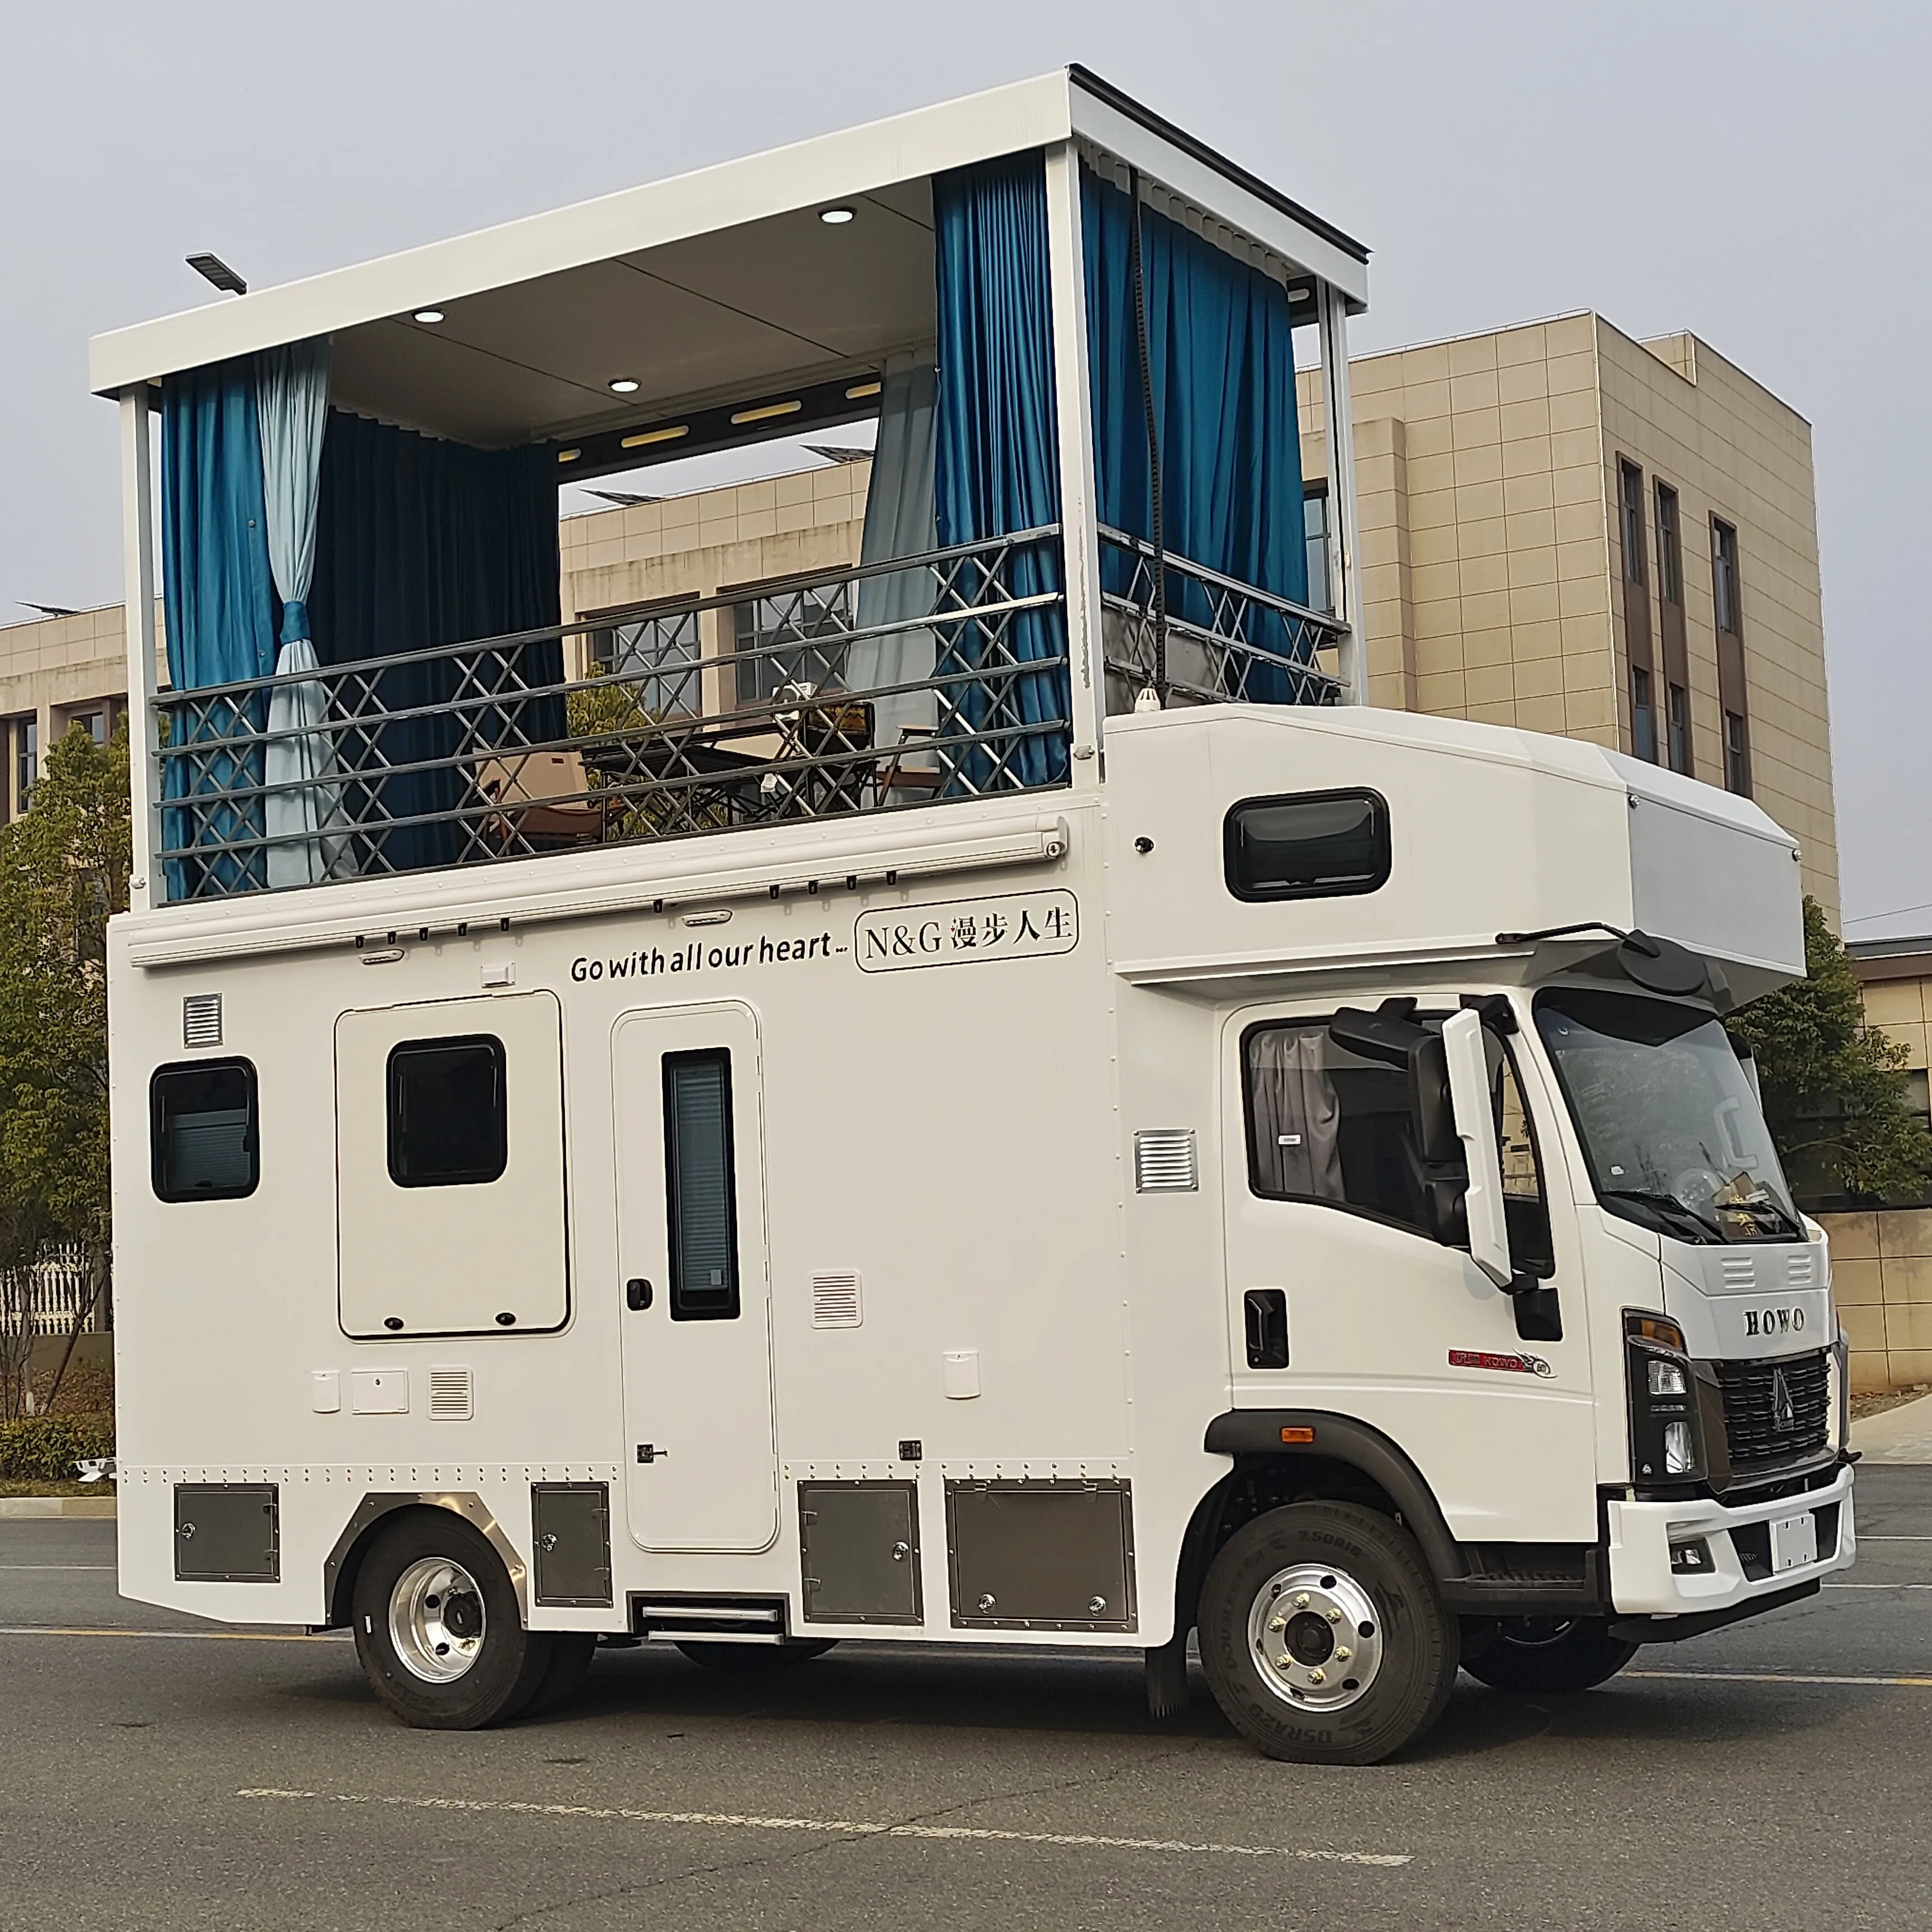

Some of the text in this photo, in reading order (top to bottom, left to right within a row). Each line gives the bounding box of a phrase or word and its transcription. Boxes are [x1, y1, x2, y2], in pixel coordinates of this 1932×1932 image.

[864, 906, 1073, 959] N&G 漫步人生
[571, 957, 603, 982] Go
[609, 946, 665, 978] with
[670, 942, 703, 973] all
[708, 944, 754, 968] our
[1743, 1308, 1805, 1337] HOWO
[1299, 1530, 1362, 1557] 7.50R16
